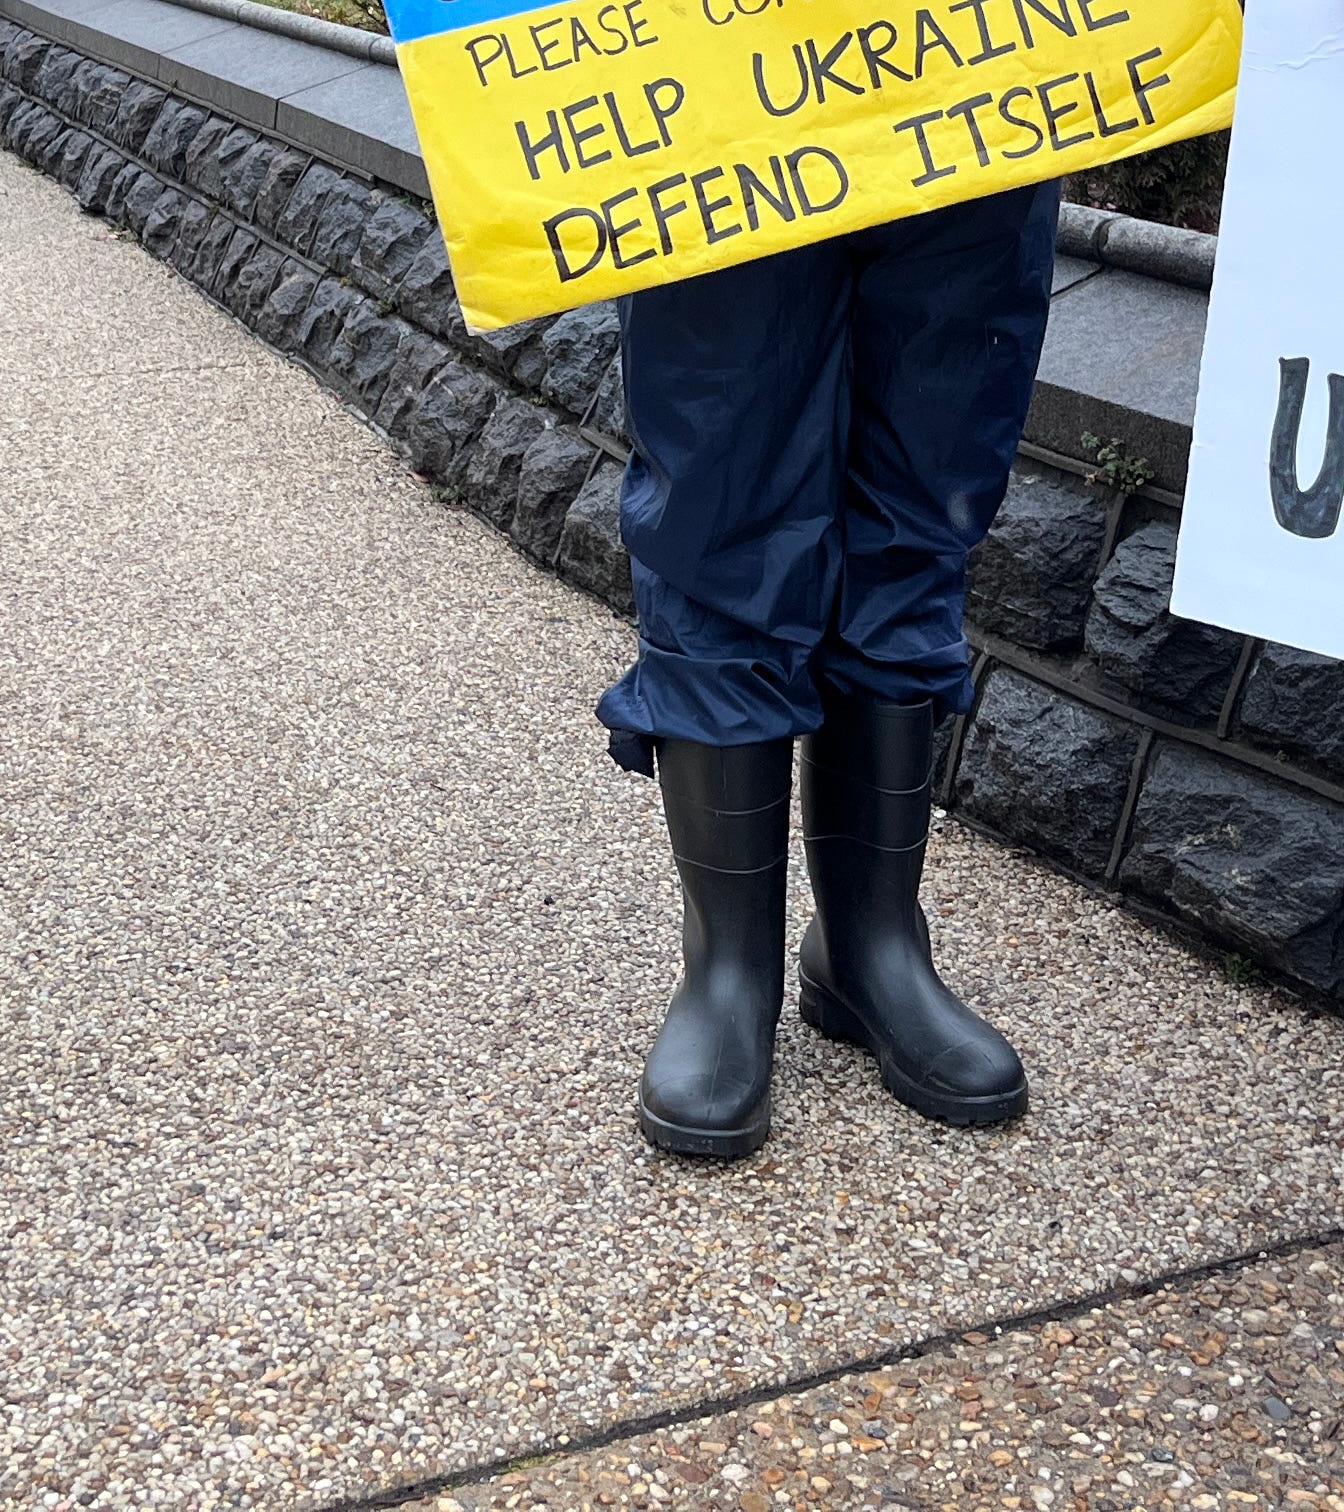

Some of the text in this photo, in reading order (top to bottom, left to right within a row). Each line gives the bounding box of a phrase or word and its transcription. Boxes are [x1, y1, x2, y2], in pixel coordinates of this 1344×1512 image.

[464, 0, 659, 87] PLEASE
[514, 79, 684, 180] HELP
[543, 49, 1170, 285] DEFEND ITSELF
